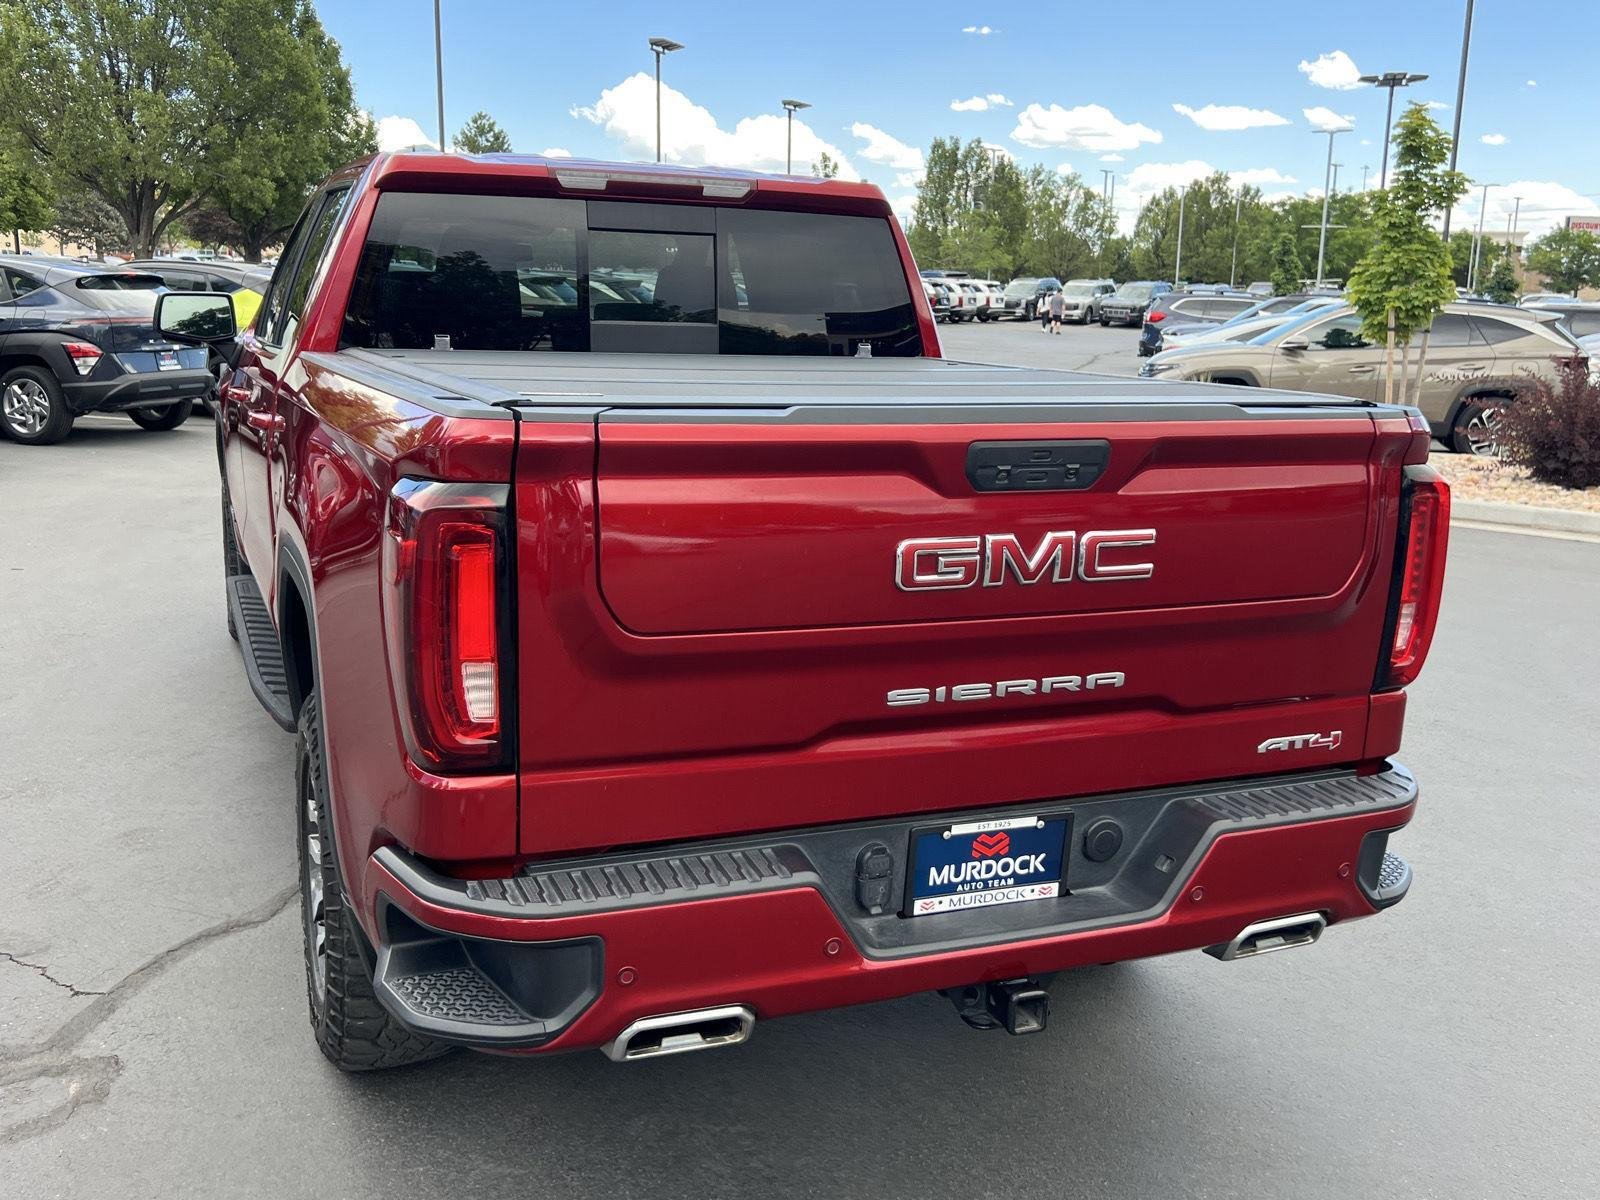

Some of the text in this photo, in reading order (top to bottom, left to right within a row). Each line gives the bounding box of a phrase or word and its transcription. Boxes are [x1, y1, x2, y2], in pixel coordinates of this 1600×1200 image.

[1571, 222, 1600, 230] DISCOUN
[895, 528, 1157, 592] GMC
[887, 671, 1126, 707] SIERRA
[1257, 730, 1342, 754] AT4
[928, 852, 1047, 887] MURDOCK
[956, 877, 1015, 892] AUTO TEAM
[948, 887, 1026, 908] MURDOCK
